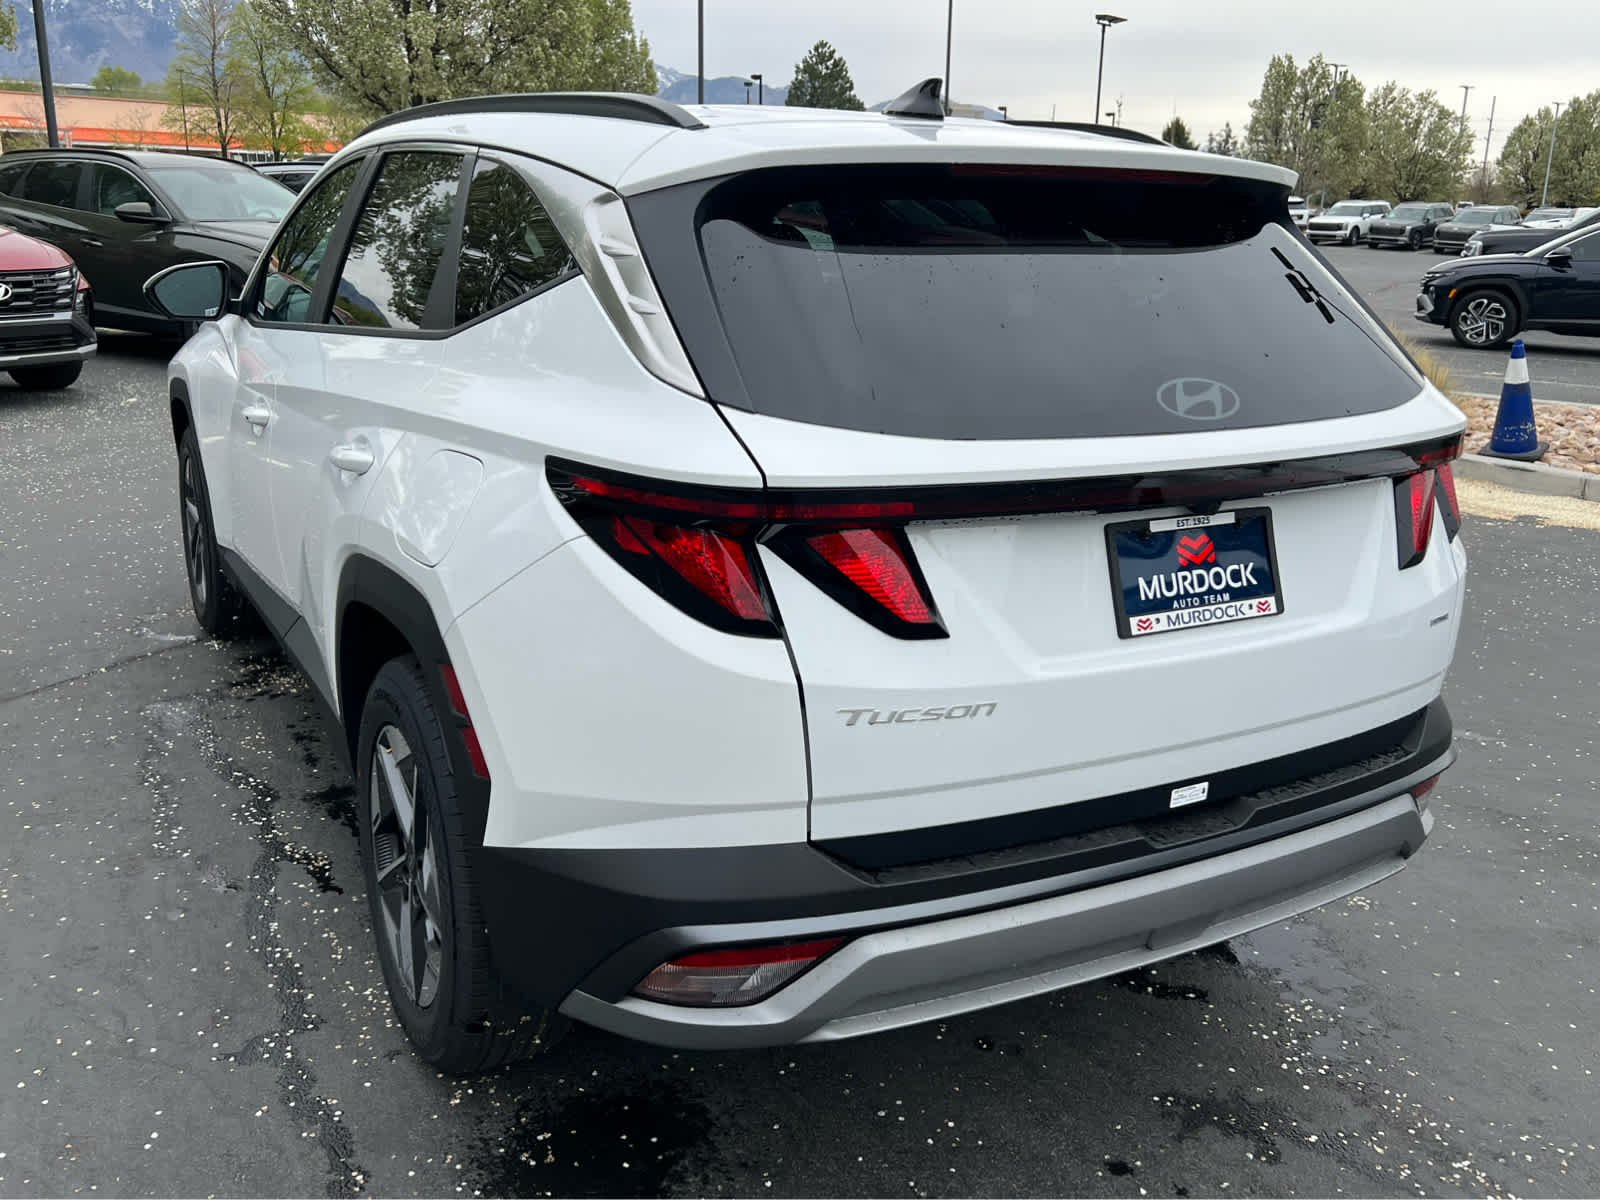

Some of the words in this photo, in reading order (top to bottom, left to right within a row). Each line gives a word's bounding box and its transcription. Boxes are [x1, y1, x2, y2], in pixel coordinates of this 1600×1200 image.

[1138, 562, 1258, 600] MURDOCK
[1172, 598, 1200, 609] AUTO
[1204, 592, 1230, 605] TEAM
[1166, 603, 1246, 627] MURDOCK
